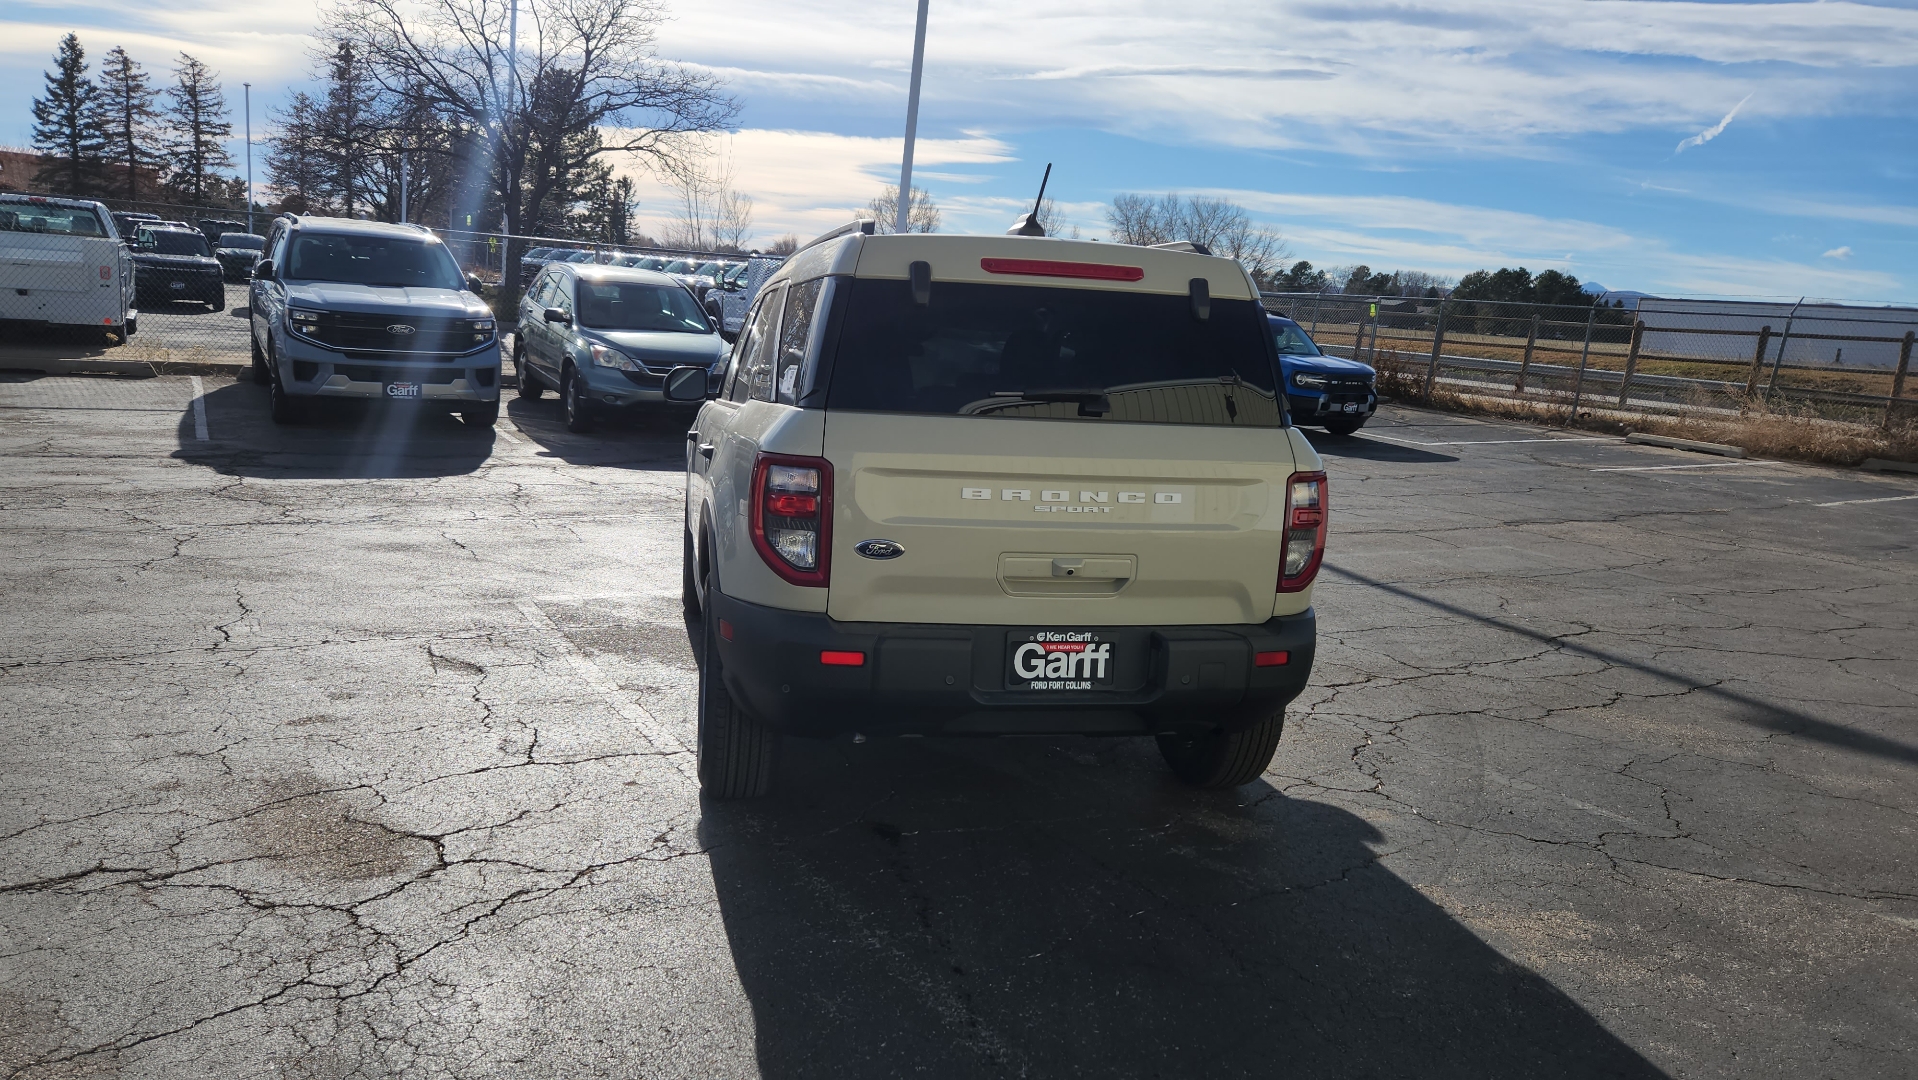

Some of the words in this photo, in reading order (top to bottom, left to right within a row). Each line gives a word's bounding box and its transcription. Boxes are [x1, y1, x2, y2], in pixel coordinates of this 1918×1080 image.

[387, 384, 418, 396] Garff
[961, 487, 1182, 504] BRONCO
[1034, 505, 1114, 513] SPORT
[866, 543, 894, 556] Ford
[1046, 631, 1066, 642] Ken
[1066, 631, 1092, 642] Garff
[1013, 642, 1110, 679] Garff
[1030, 681, 1047, 690] FORD
[1048, 681, 1064, 690] FORT
[1065, 681, 1091, 690] COLLINS
